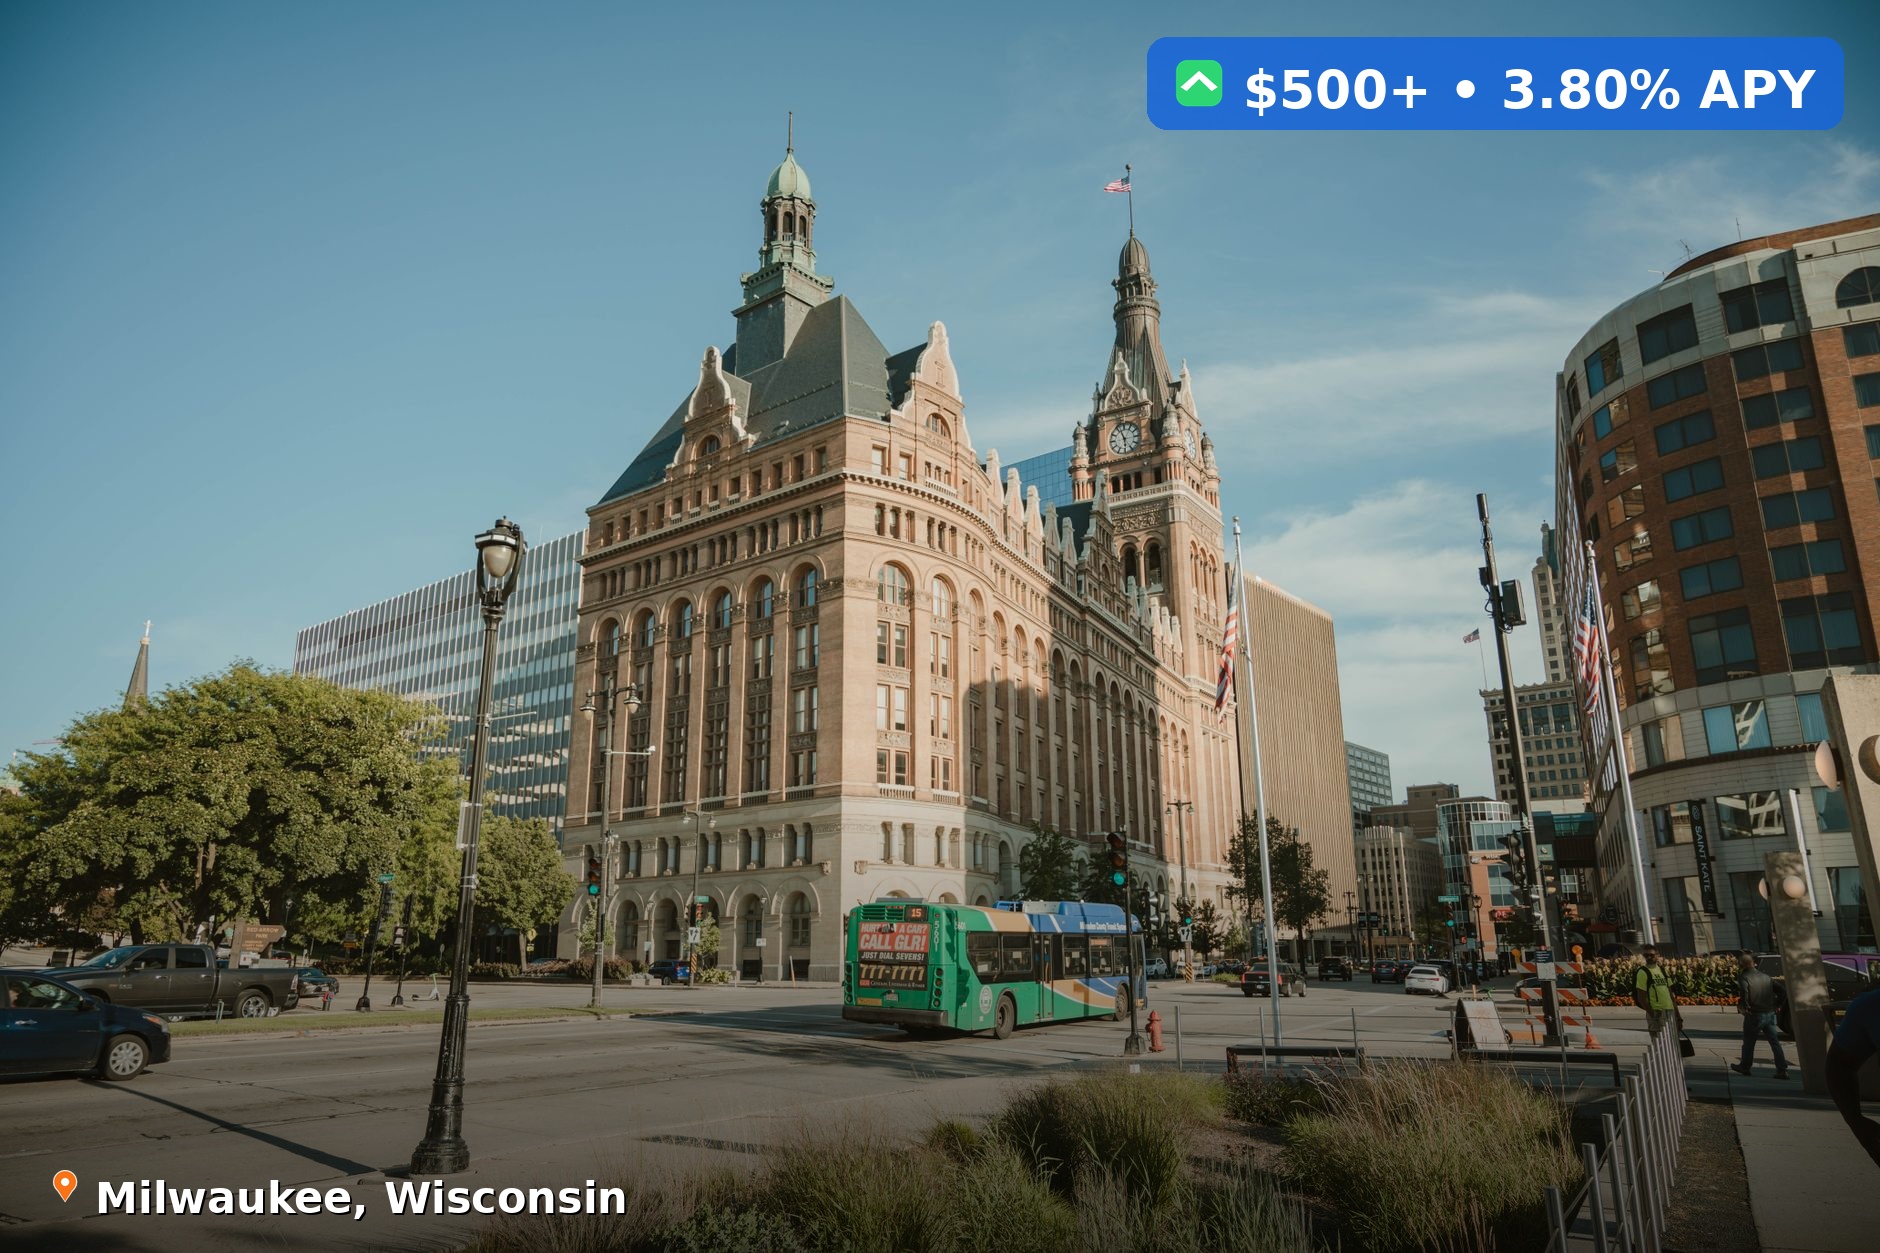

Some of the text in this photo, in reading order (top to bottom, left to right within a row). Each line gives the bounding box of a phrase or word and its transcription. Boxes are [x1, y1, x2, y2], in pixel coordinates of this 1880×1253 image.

[1695, 825, 1707, 861] SAINT
[1701, 862, 1711, 893] KATE
[911, 908, 922, 917] 15
[906, 924, 928, 934] CAR?
[861, 933, 926, 951] CALL GLR!
[861, 951, 877, 959] JUST
[879, 952, 894, 960] DIAL
[860, 963, 925, 981] 777-7777
